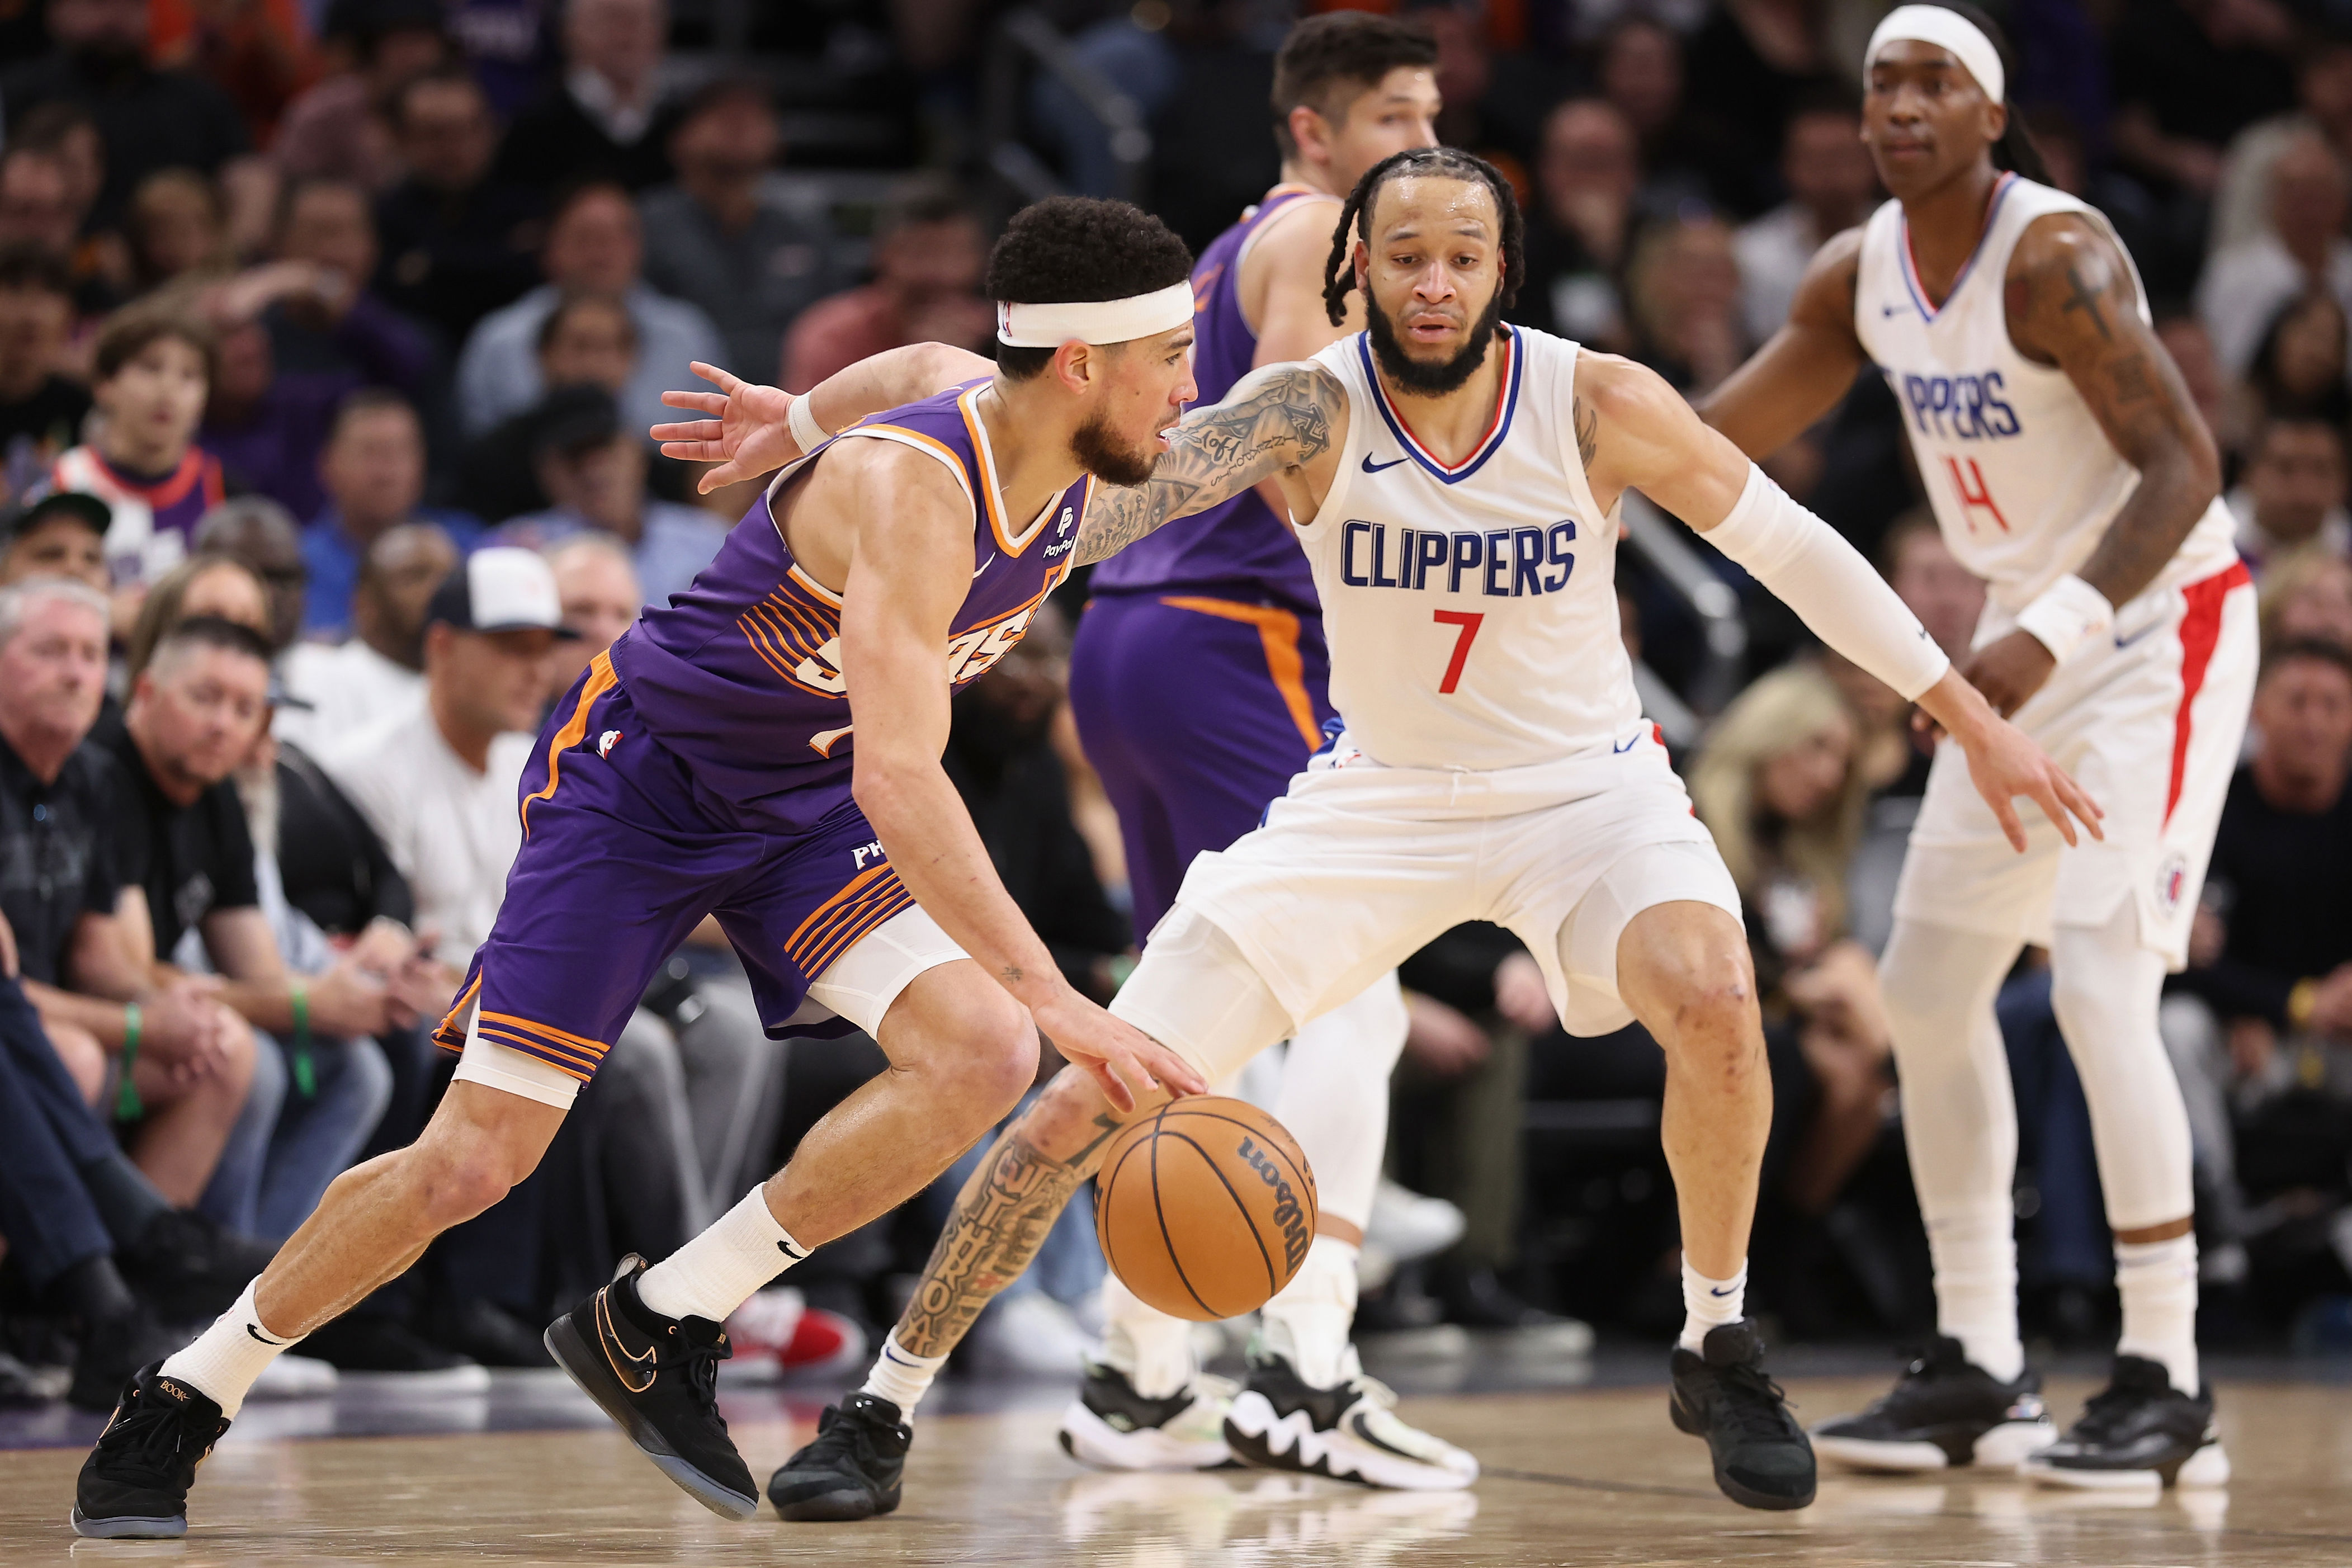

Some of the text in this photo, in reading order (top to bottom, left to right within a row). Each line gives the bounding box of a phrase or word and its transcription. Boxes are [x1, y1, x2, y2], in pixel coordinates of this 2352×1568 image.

[1882, 370, 2020, 439] IPPERS
[1938, 454, 2010, 533] 14
[1042, 535, 1075, 558] PayPal
[1340, 519, 1576, 597] CLIPPERS
[795, 610, 1029, 693] SNS
[1433, 609, 1485, 694] 7
[851, 839, 885, 870] PH
[160, 1380, 190, 1402] BOOK
